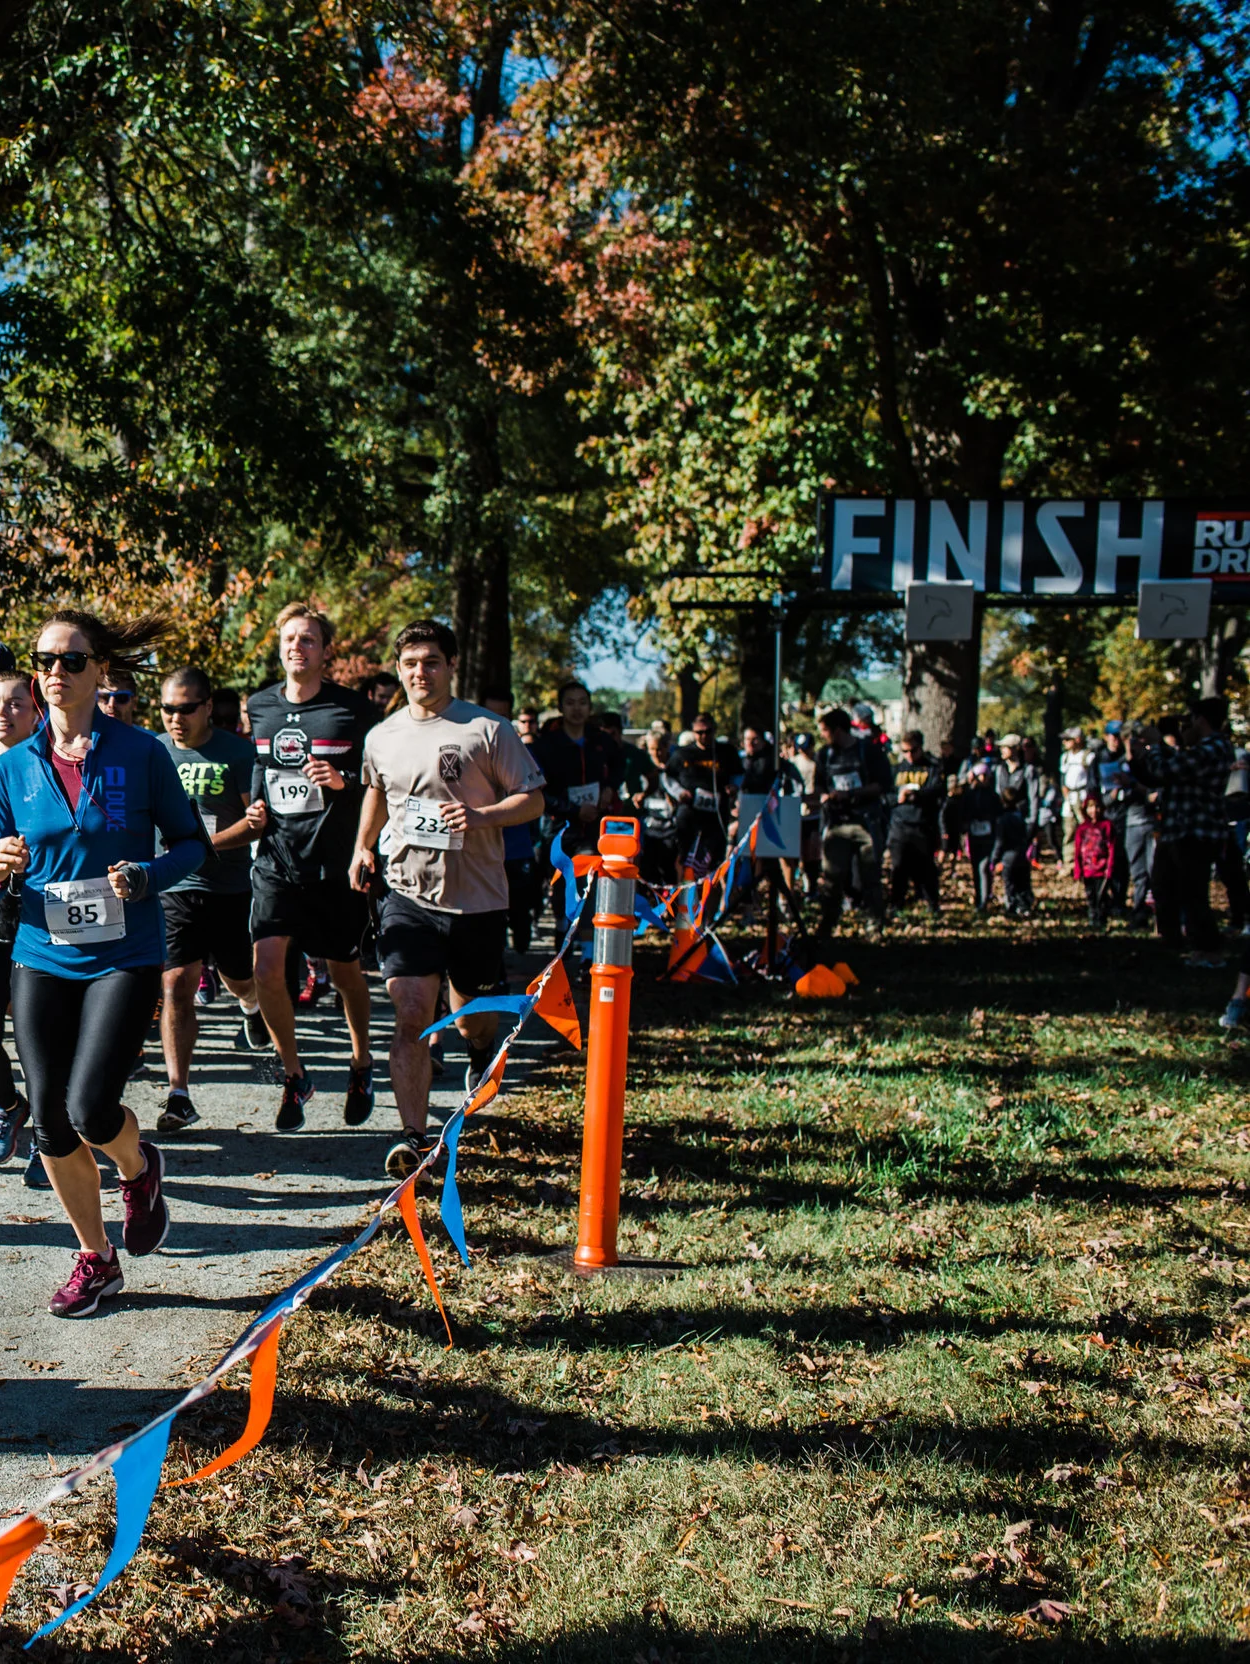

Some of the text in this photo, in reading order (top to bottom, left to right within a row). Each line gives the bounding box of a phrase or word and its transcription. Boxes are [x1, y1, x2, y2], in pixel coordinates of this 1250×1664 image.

[831, 499, 1165, 594] FINISH
[1192, 548, 1250, 573] DR
[177, 762, 229, 780] CITY
[280, 785, 308, 799] 199
[105, 790, 127, 832] DUKE
[415, 816, 449, 834] 232
[67, 904, 98, 925] 85
